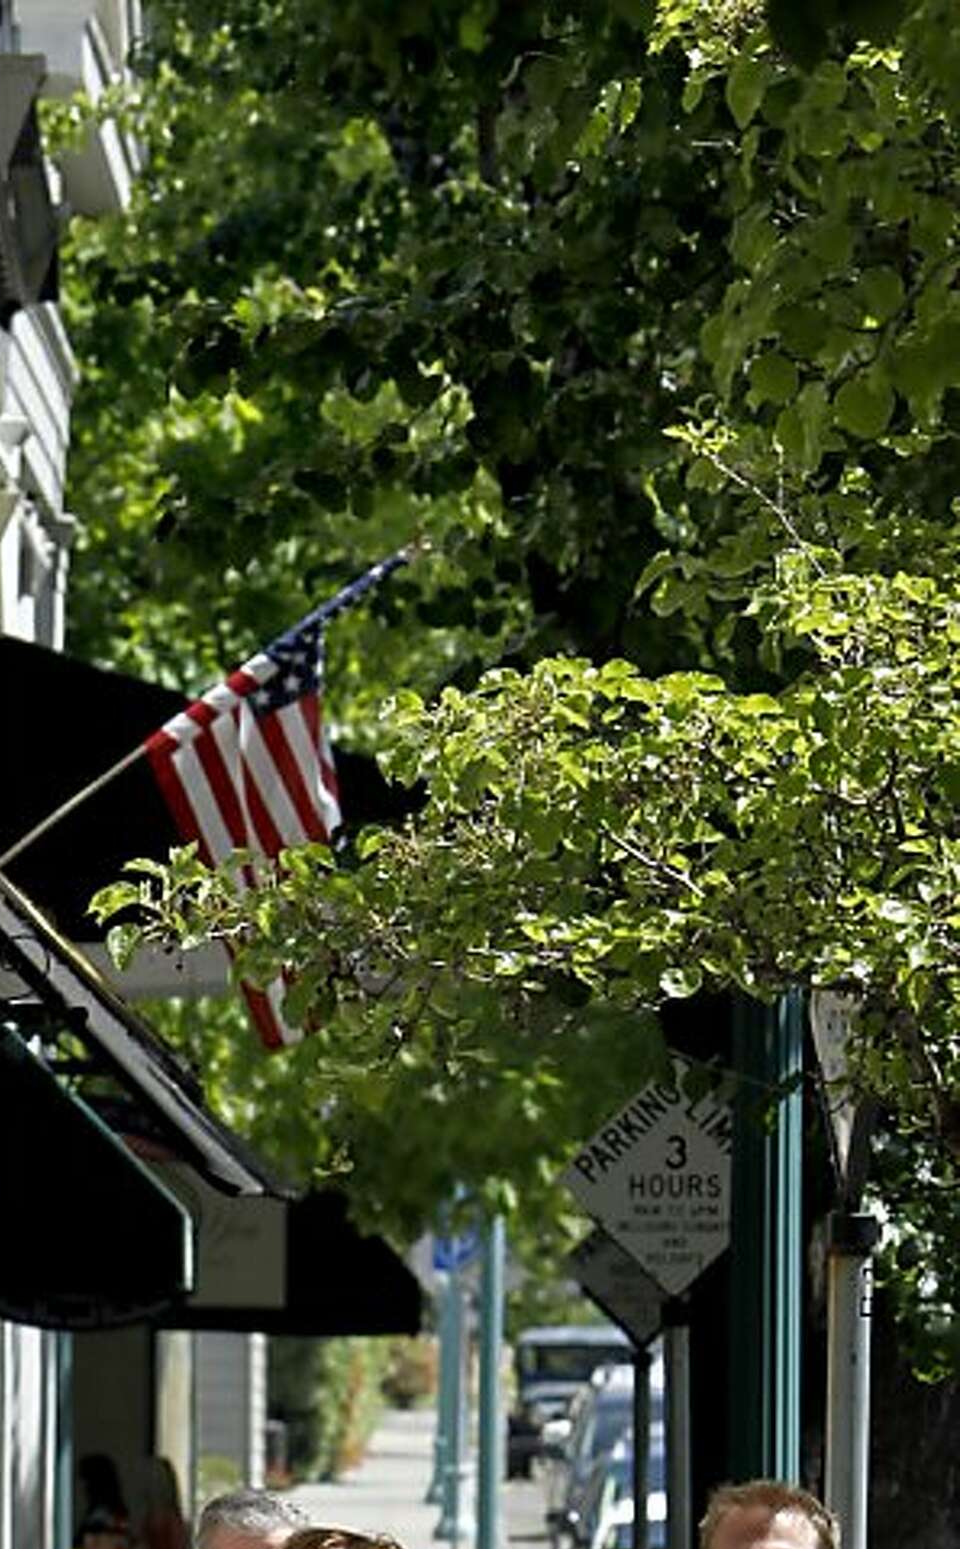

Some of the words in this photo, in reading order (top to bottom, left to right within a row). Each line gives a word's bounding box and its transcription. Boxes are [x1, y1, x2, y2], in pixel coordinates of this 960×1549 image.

[573, 1078, 681, 1184] PARKING
[665, 1135, 688, 1169] 3
[629, 1174, 722, 1199] HOURS
